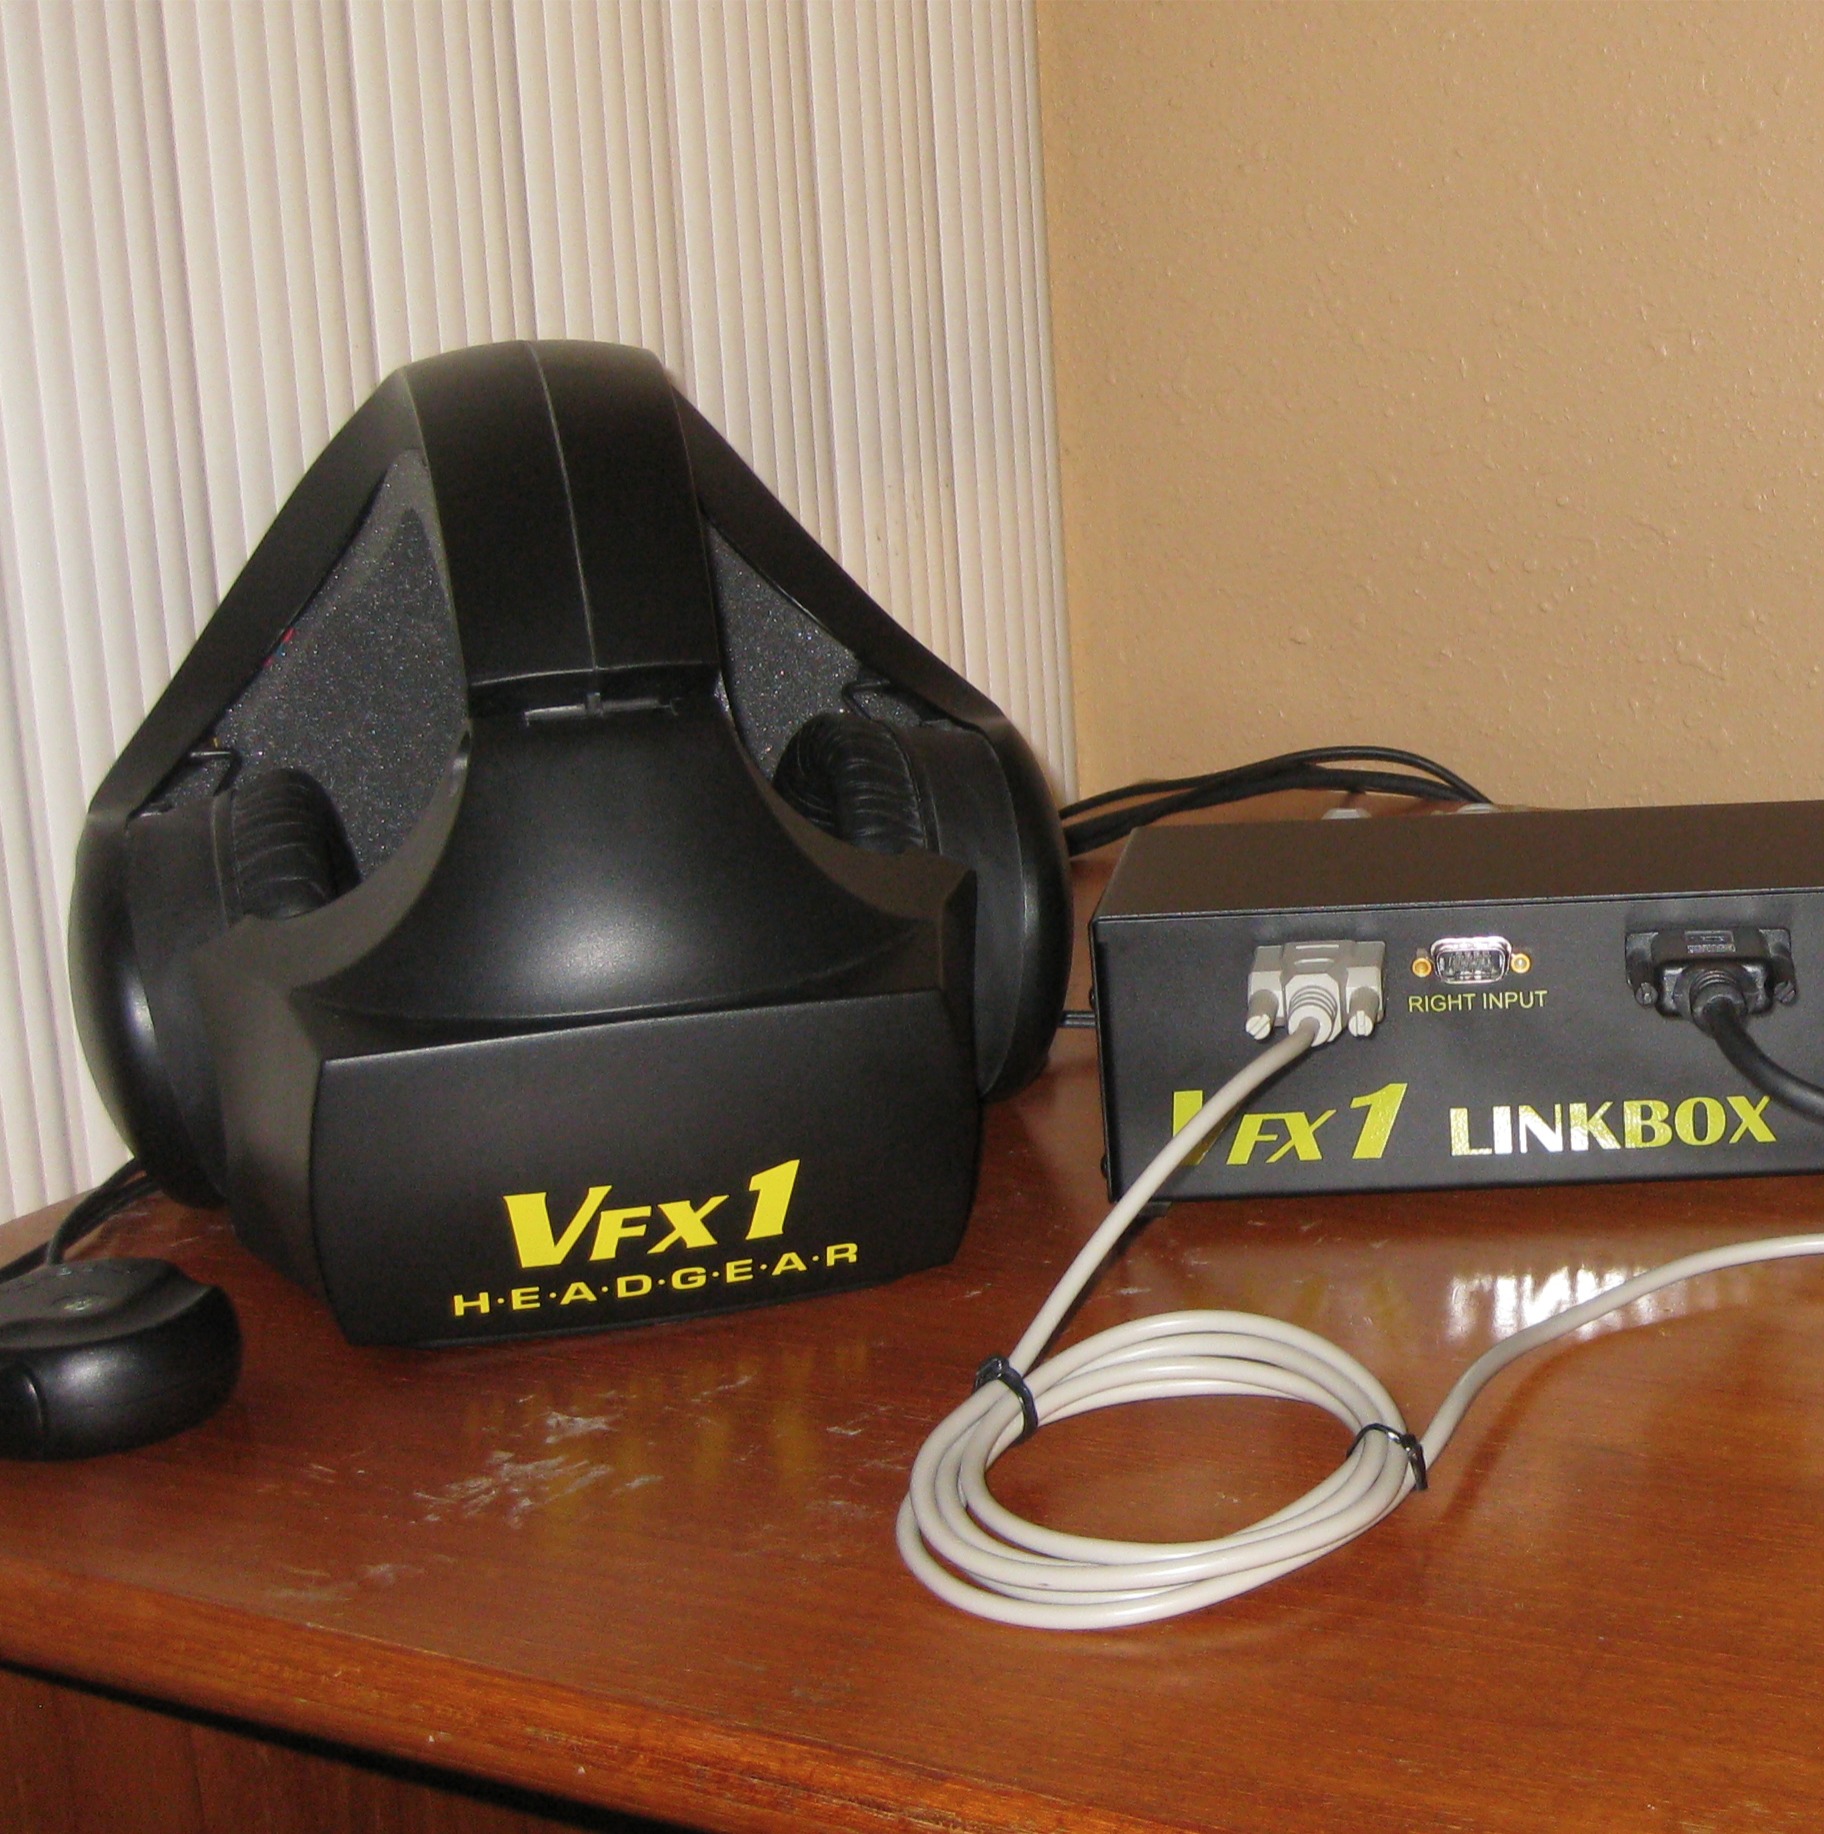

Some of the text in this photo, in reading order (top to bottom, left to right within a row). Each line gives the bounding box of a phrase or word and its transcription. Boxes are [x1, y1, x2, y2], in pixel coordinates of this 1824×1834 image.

[1408, 990, 1548, 1013] RIGHT INPUT
[1450, 1094, 1778, 1157] LINKBOX
